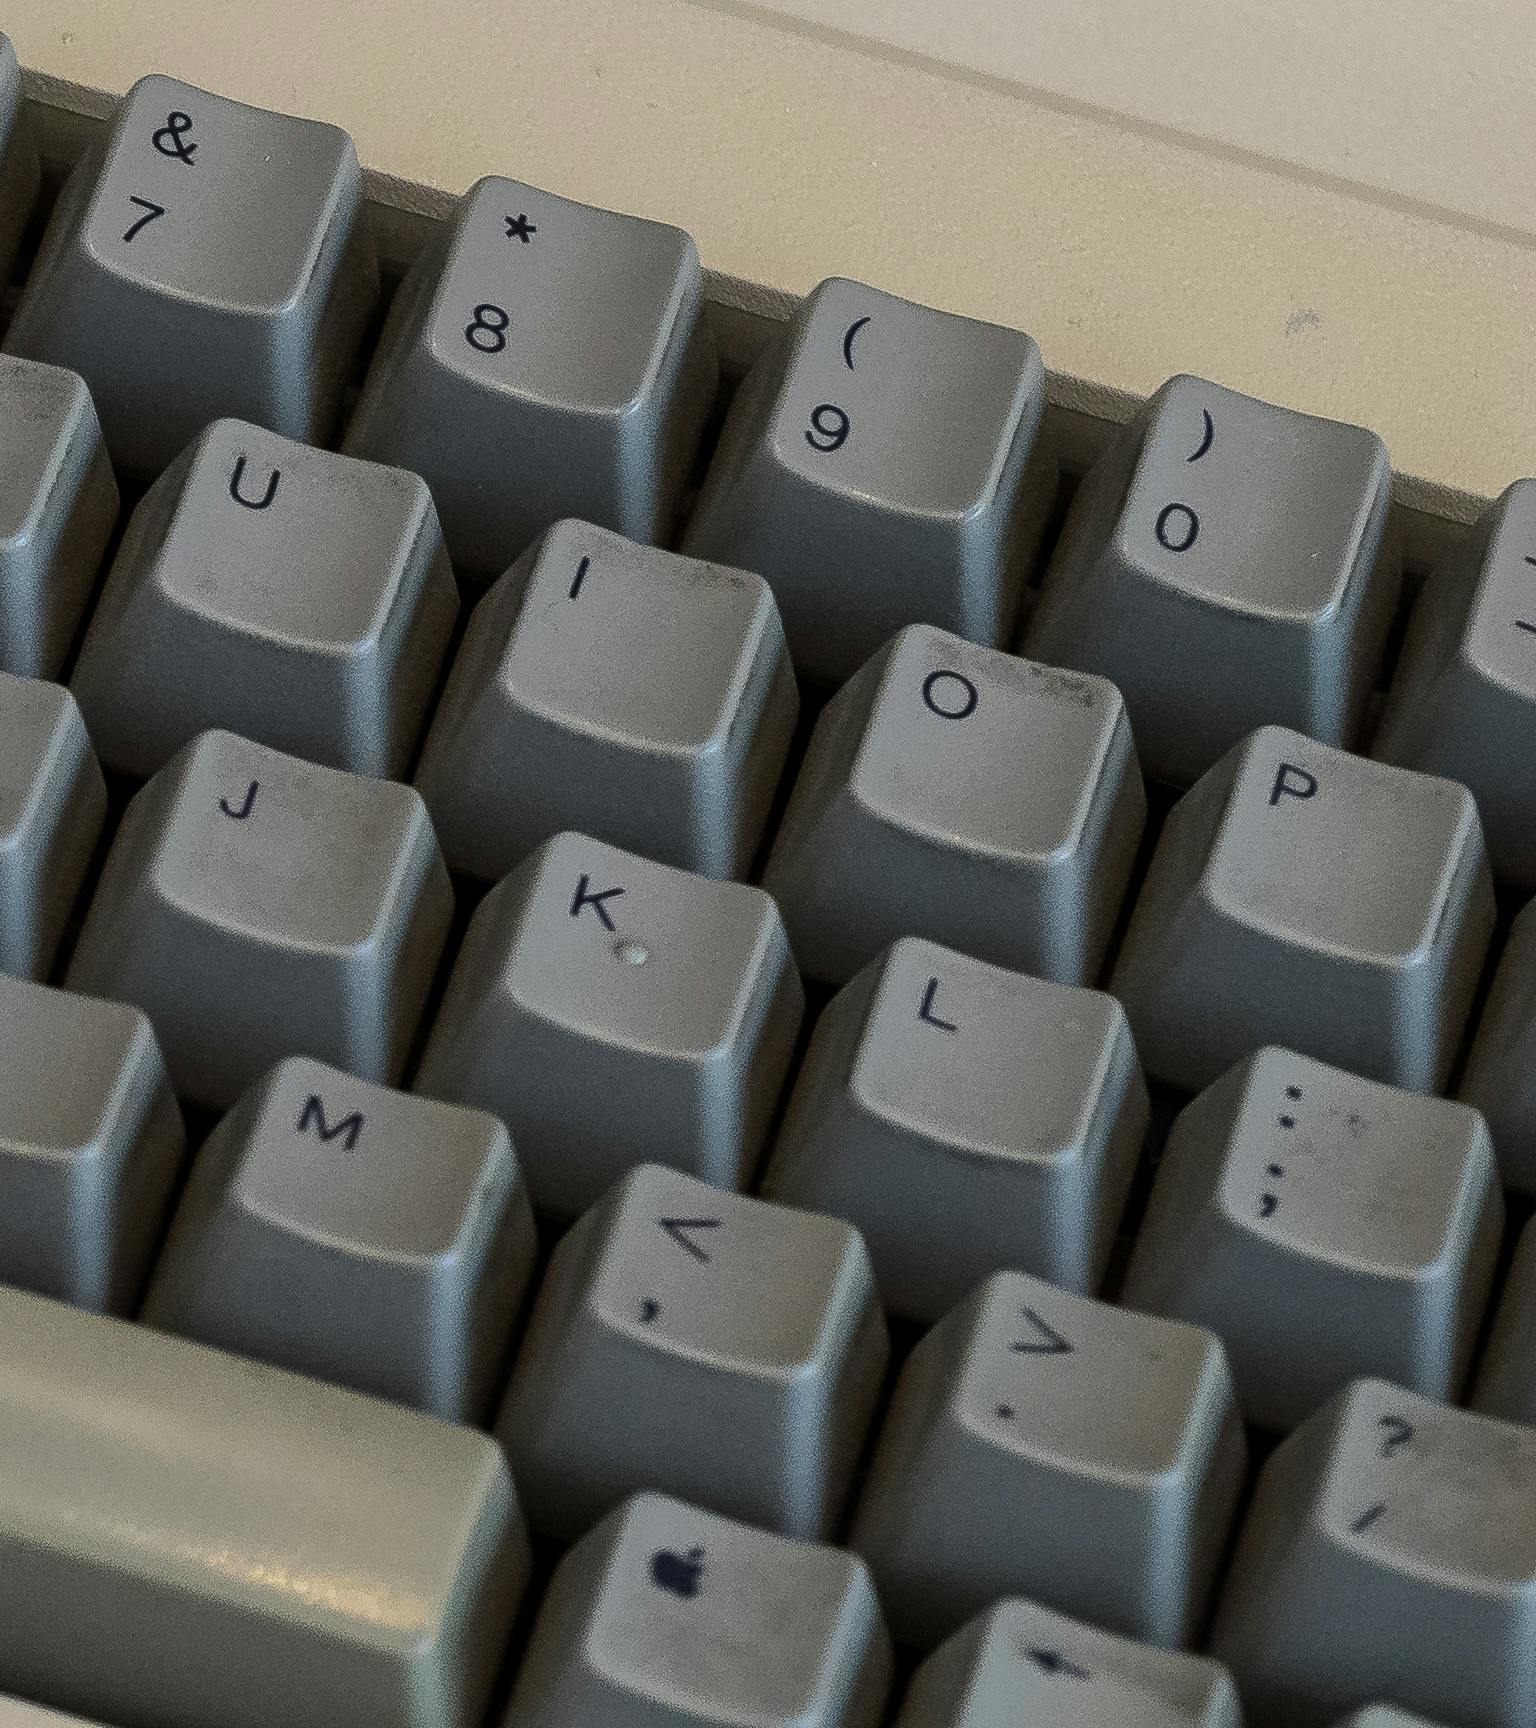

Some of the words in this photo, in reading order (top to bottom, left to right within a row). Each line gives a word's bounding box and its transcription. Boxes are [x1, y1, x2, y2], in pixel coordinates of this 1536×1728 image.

[150, 110, 198, 167] &
[122, 195, 167, 244] 7
[463, 302, 511, 356] 8
[841, 316, 871, 370] (
[804, 403, 852, 454] 9
[1187, 409, 1216, 464] )
[228, 455, 282, 511] U
[567, 555, 592, 601] I
[920, 668, 980, 722] O
[218, 779, 261, 822] J
[1268, 761, 1320, 807] P
[569, 874, 626, 933] K
[917, 977, 958, 1034] L
[296, 1094, 366, 1152] M
